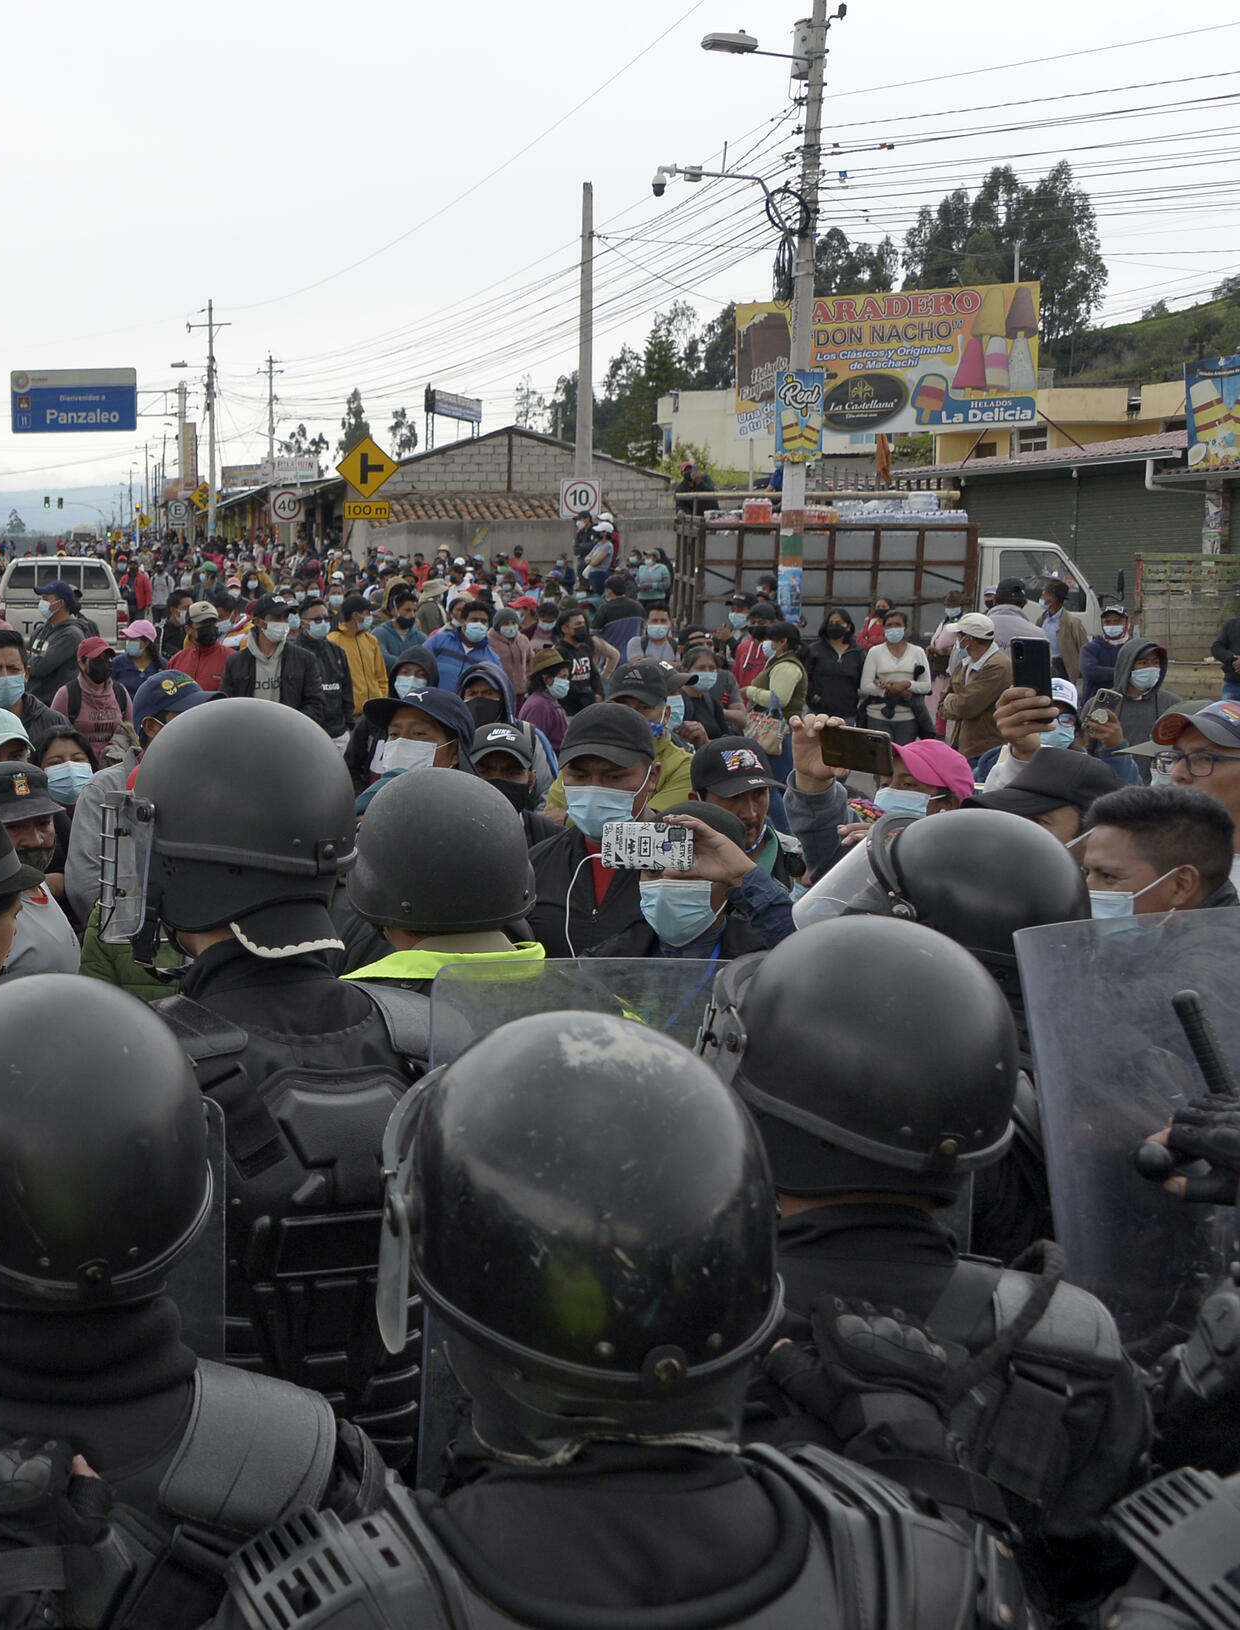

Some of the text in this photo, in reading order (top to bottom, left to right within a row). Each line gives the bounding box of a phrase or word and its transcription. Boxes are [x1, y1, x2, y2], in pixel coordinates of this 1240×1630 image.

[812, 290, 982, 323] ARADERO
[816, 343, 954, 361] Los Clásicos y Originales
[751, 355, 789, 385] Helado
[850, 361, 864, 370] de
[60, 394, 99, 403] Bienvenidos
[780, 381, 822, 409] Real
[829, 402, 843, 411] La
[845, 399, 895, 410] Castellana
[971, 399, 1013, 409] HELADOS
[46, 408, 120, 425] Panzaleo
[738, 409, 761, 424] Una
[941, 406, 1033, 423] La Delicia
[741, 427, 749, 436] a
[749, 420, 763, 433] tu
[569, 489, 589, 506] 10
[174, 504, 181, 514] E
[278, 500, 296, 512] 40
[348, 505, 387, 516] 100 m
